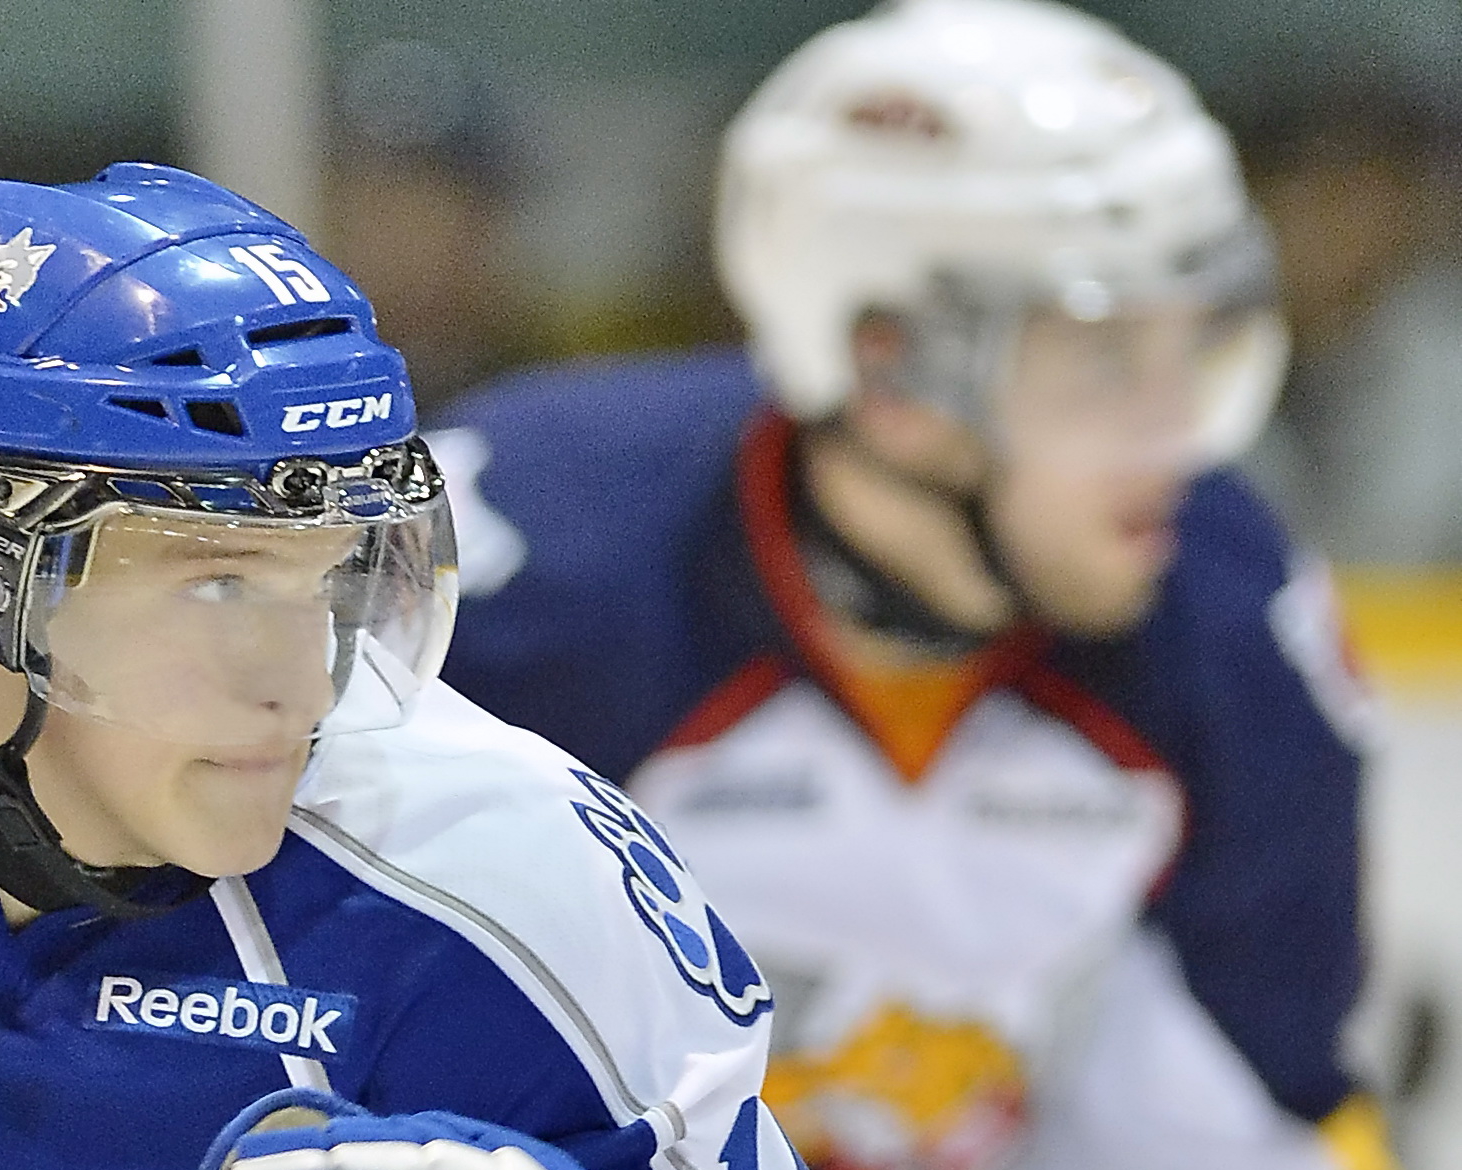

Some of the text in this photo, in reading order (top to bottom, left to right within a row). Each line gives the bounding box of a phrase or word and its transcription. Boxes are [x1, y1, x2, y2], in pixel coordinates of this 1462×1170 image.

[227, 243, 332, 306] 15
[280, 392, 393, 433] CCM
[95, 975, 342, 1055] Reebok
